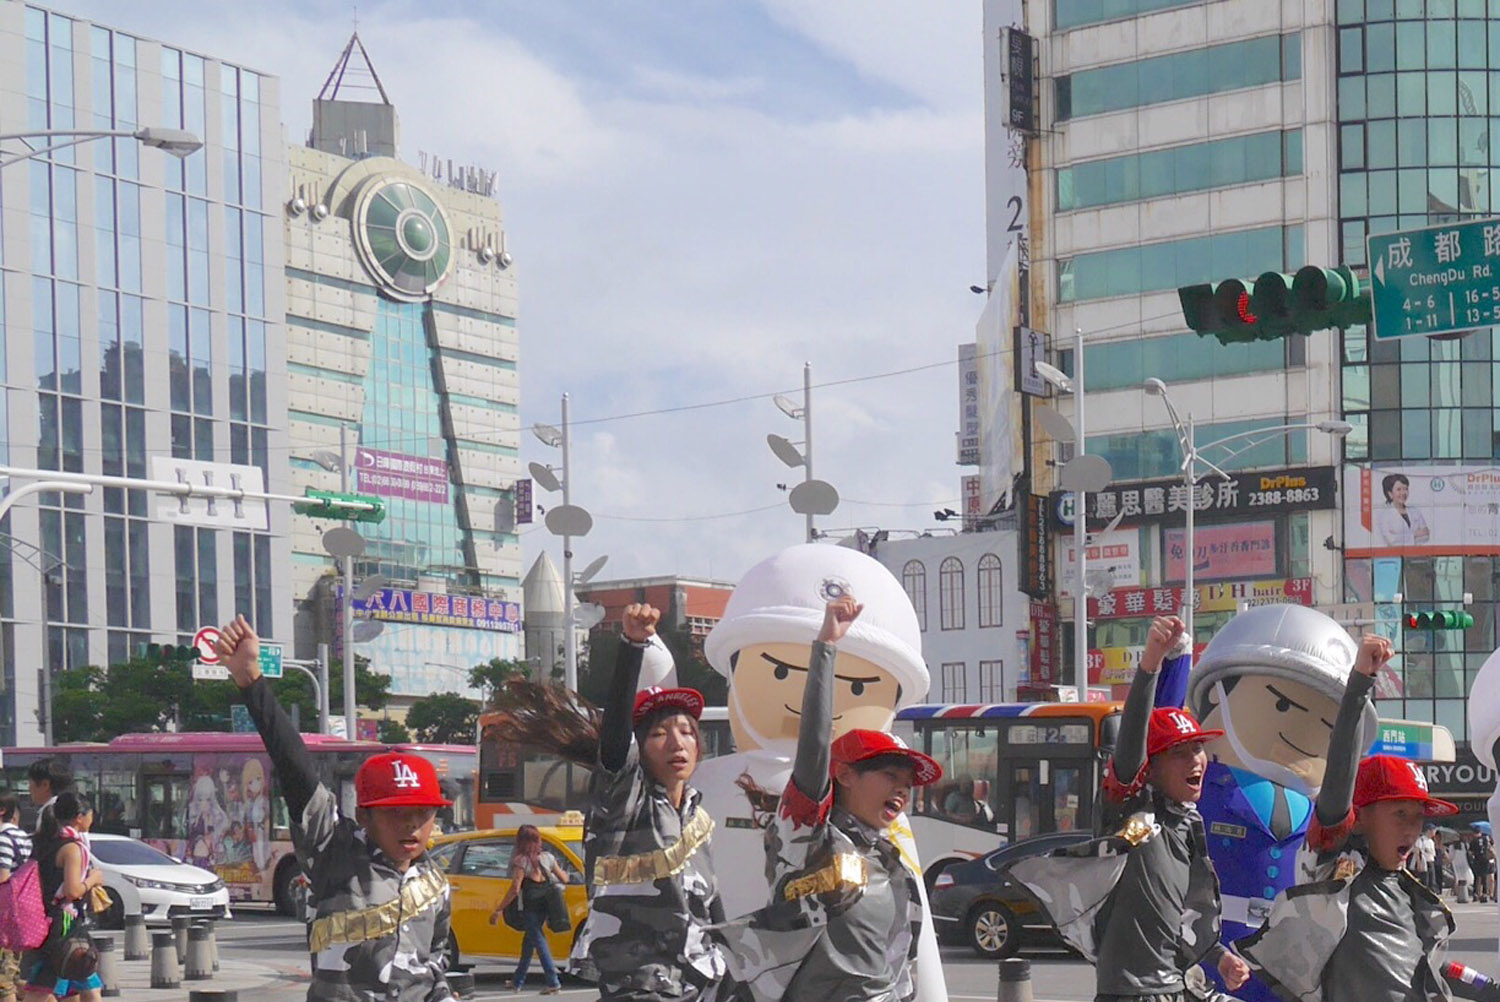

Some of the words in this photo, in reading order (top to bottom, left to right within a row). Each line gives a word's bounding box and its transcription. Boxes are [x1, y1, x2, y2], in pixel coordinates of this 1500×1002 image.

[1410, 268, 1465, 287] ChengDu
[1473, 265, 1492, 279] Rd.
[1260, 475, 1306, 490] DrPlus
[1248, 487, 1320, 507] 2388-8863
[1253, 586, 1281, 597] hair
[1292, 578, 1311, 592] 3F
[1168, 711, 1197, 734] LA
[1382, 730, 1406, 744] 西門站
[391, 760, 420, 788] LA
